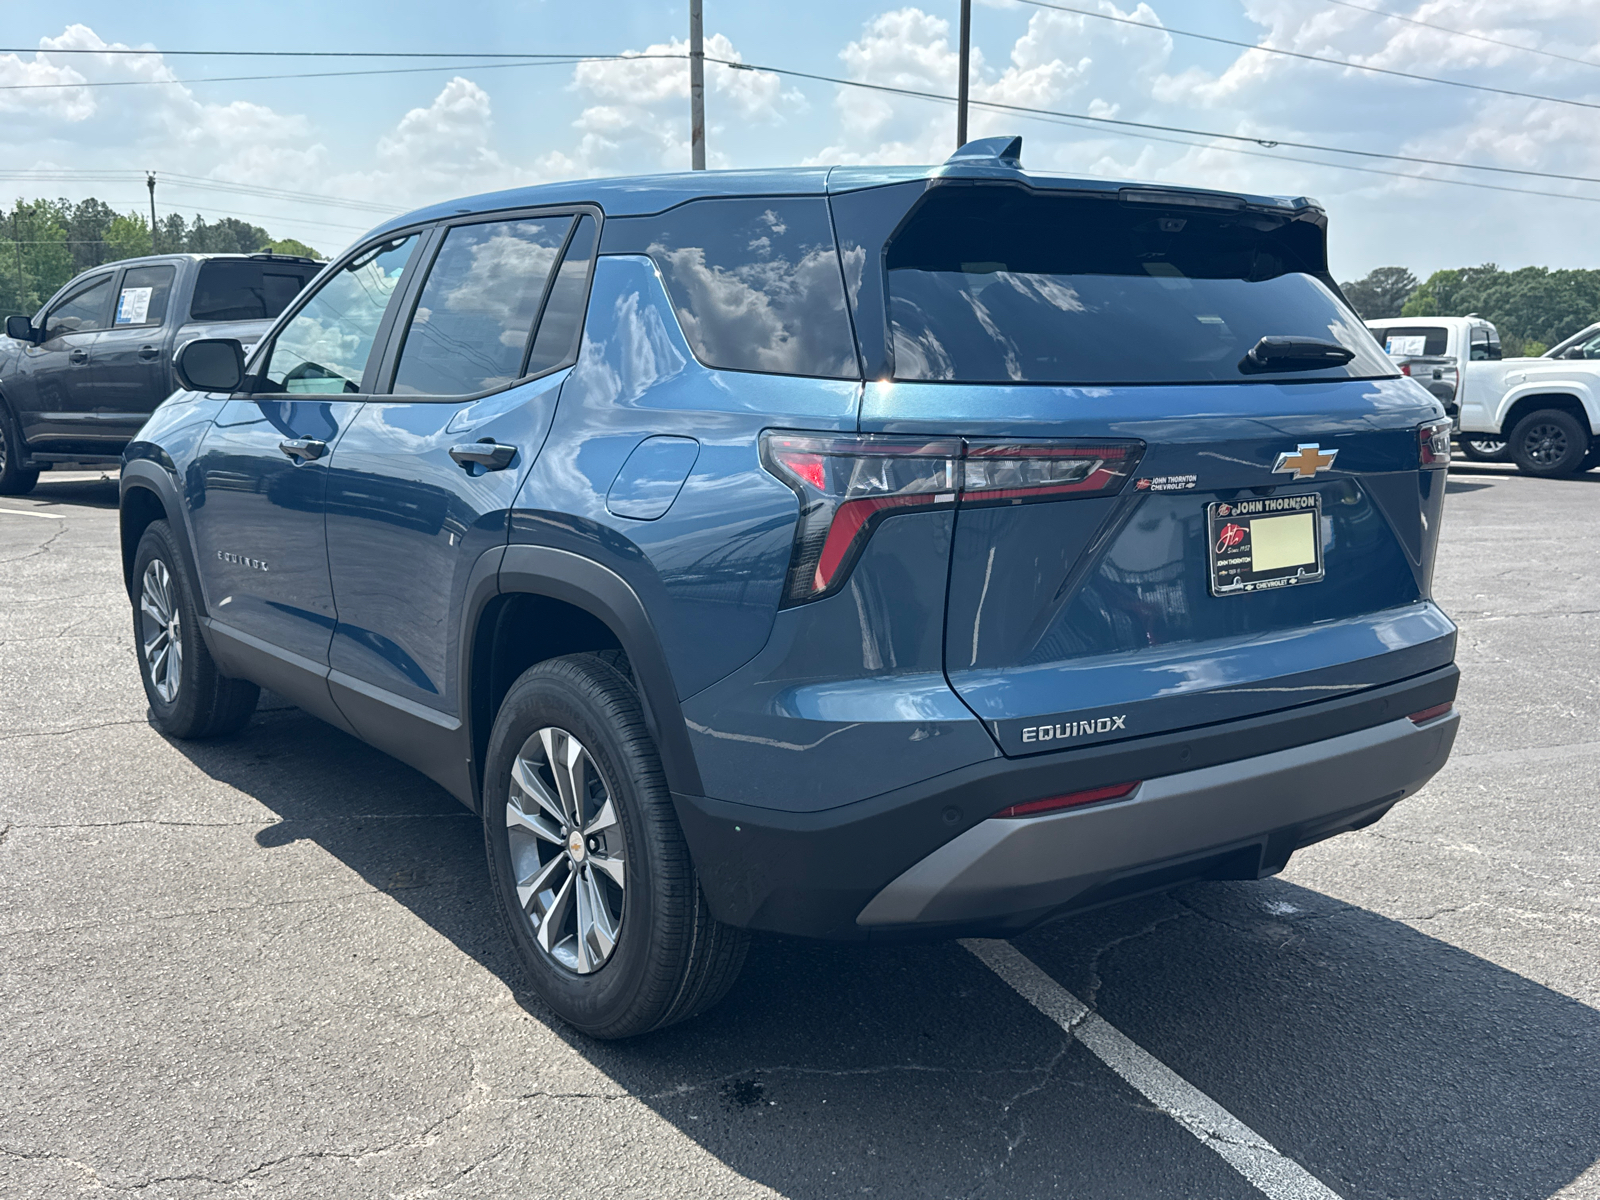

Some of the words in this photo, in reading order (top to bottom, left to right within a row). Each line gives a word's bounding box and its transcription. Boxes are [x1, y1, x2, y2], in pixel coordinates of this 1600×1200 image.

[1151, 477, 1167, 485] JOHN
[1167, 474, 1197, 484] THORNTON
[1150, 482, 1186, 491] CHEVROLET
[1236, 501, 1263, 514] JOHN
[1264, 496, 1315, 511] THORNTON
[1216, 559, 1229, 567] JOHN
[1228, 556, 1252, 566] THORNTON
[1255, 579, 1288, 590] CHEVROLET
[1022, 714, 1127, 743] EQUINOX
